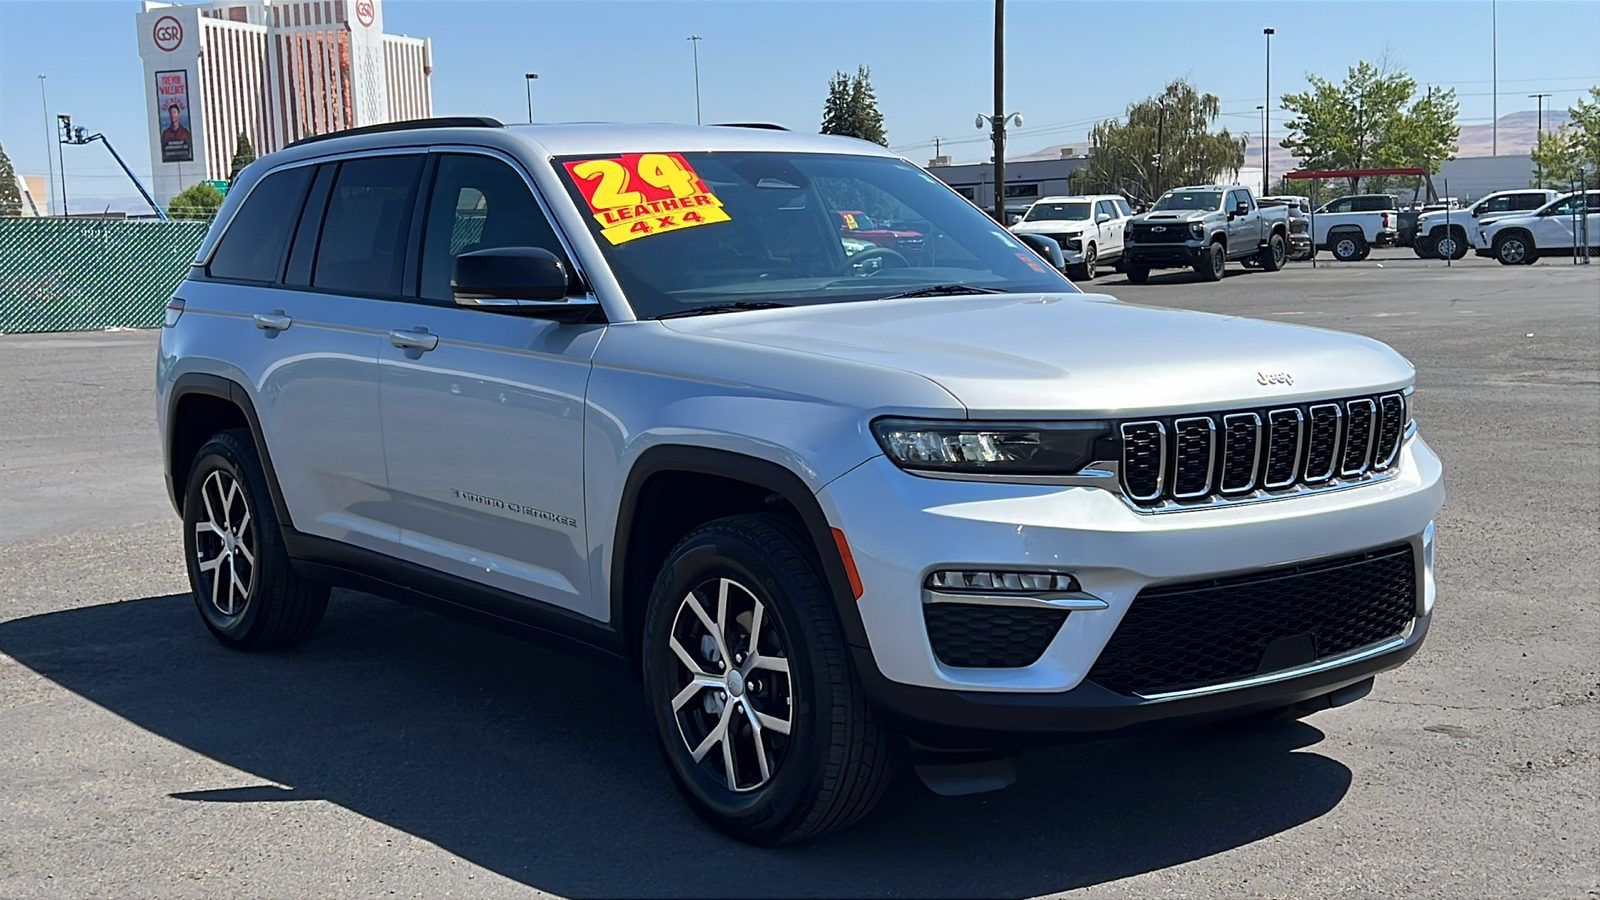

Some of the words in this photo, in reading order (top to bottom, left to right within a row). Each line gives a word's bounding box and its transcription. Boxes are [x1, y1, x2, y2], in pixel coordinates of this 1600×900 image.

[157, 26, 178, 41] GSR
[573, 154, 700, 209] 24
[603, 195, 713, 224] LEATHER
[1257, 372, 1294, 386] Jeep
[461, 491, 505, 509] GRAND
[507, 503, 578, 528] CHEROKEE
